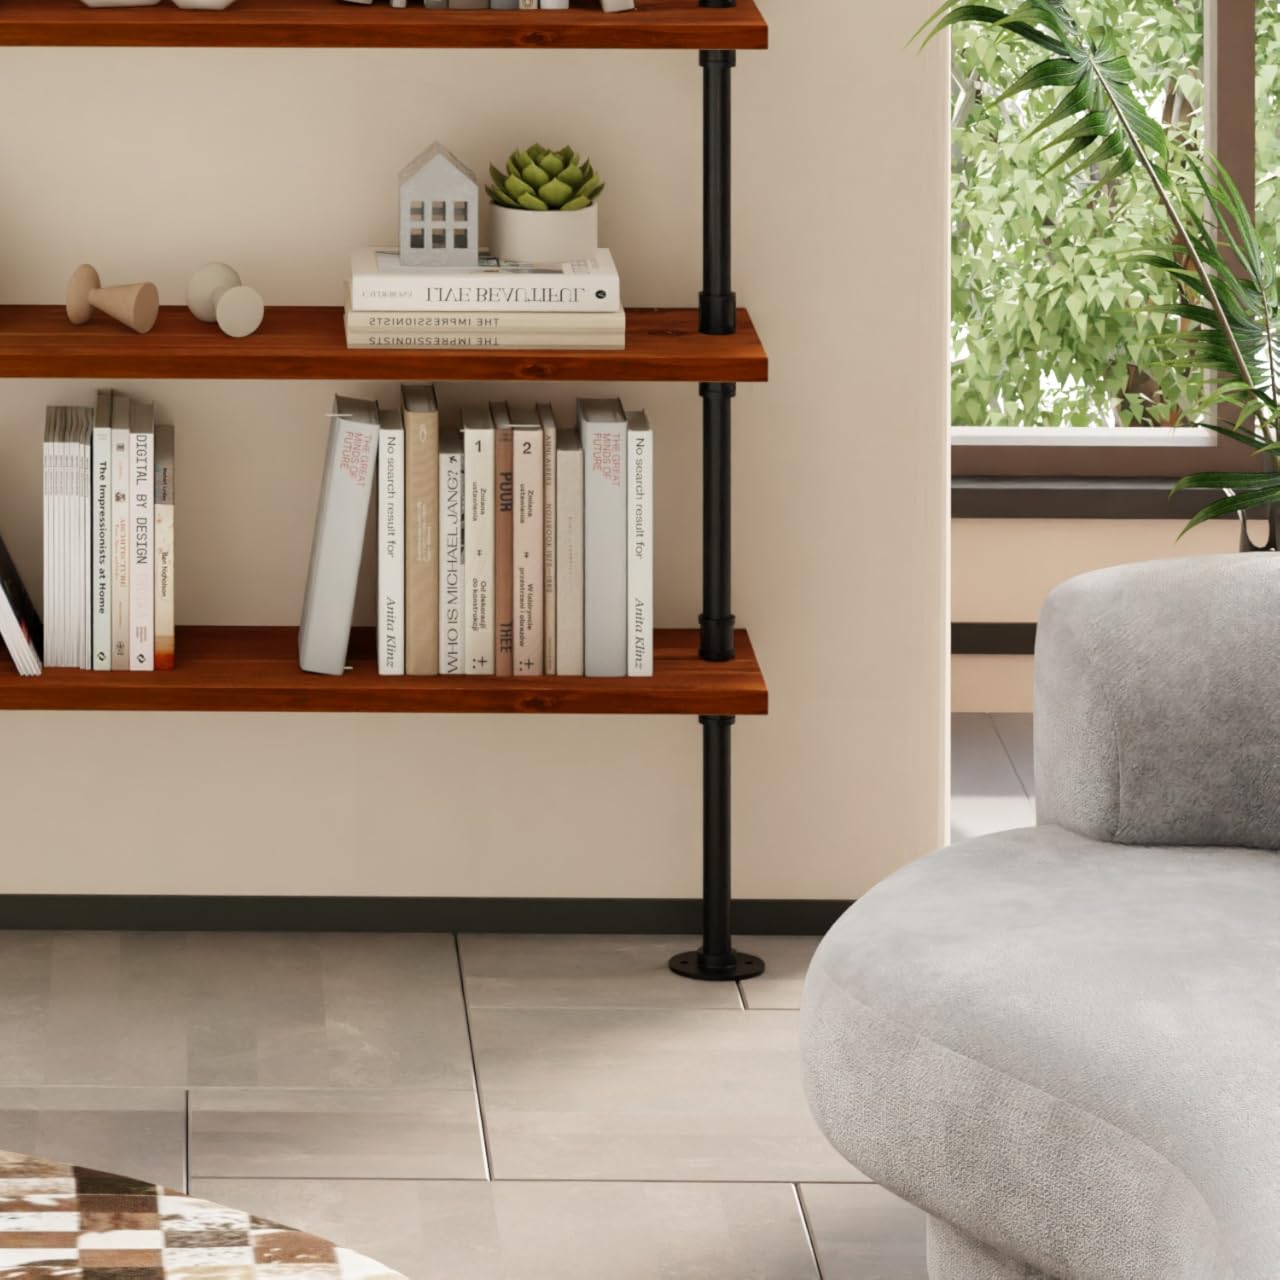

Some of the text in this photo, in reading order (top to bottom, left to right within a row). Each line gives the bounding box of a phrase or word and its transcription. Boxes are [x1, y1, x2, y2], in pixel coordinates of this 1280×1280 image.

[368, 337, 499, 346] THE IMPRESSIONISTS
[136, 434, 148, 485] DIGITAL
[339, 431, 354, 470] FUTURE
[350, 431, 362, 464] MINDS
[356, 434, 373, 488] THE GREAT
[474, 439, 484, 453] 1
[523, 441, 532, 455] 2
[592, 432, 602, 472] FUTURE
[601, 433, 611, 465] MINDS
[611, 432, 621, 487] THE GREAT
[136, 494, 148, 509] BY
[386, 436, 396, 558] No search result for
[499, 471, 513, 513] PUUR
[634, 437, 645, 560] No search result for
[98, 461, 107, 615] The Impressionists at Home
[136, 517, 148, 564] DESIGN
[160, 551, 169, 598] Ben Nicholson
[446, 469, 458, 674] WHO IS MICHAEL JANG?
[385, 596, 396, 669] Anita Klinz
[500, 622, 512, 654] THEE
[634, 598, 645, 671] Anita Klinz
